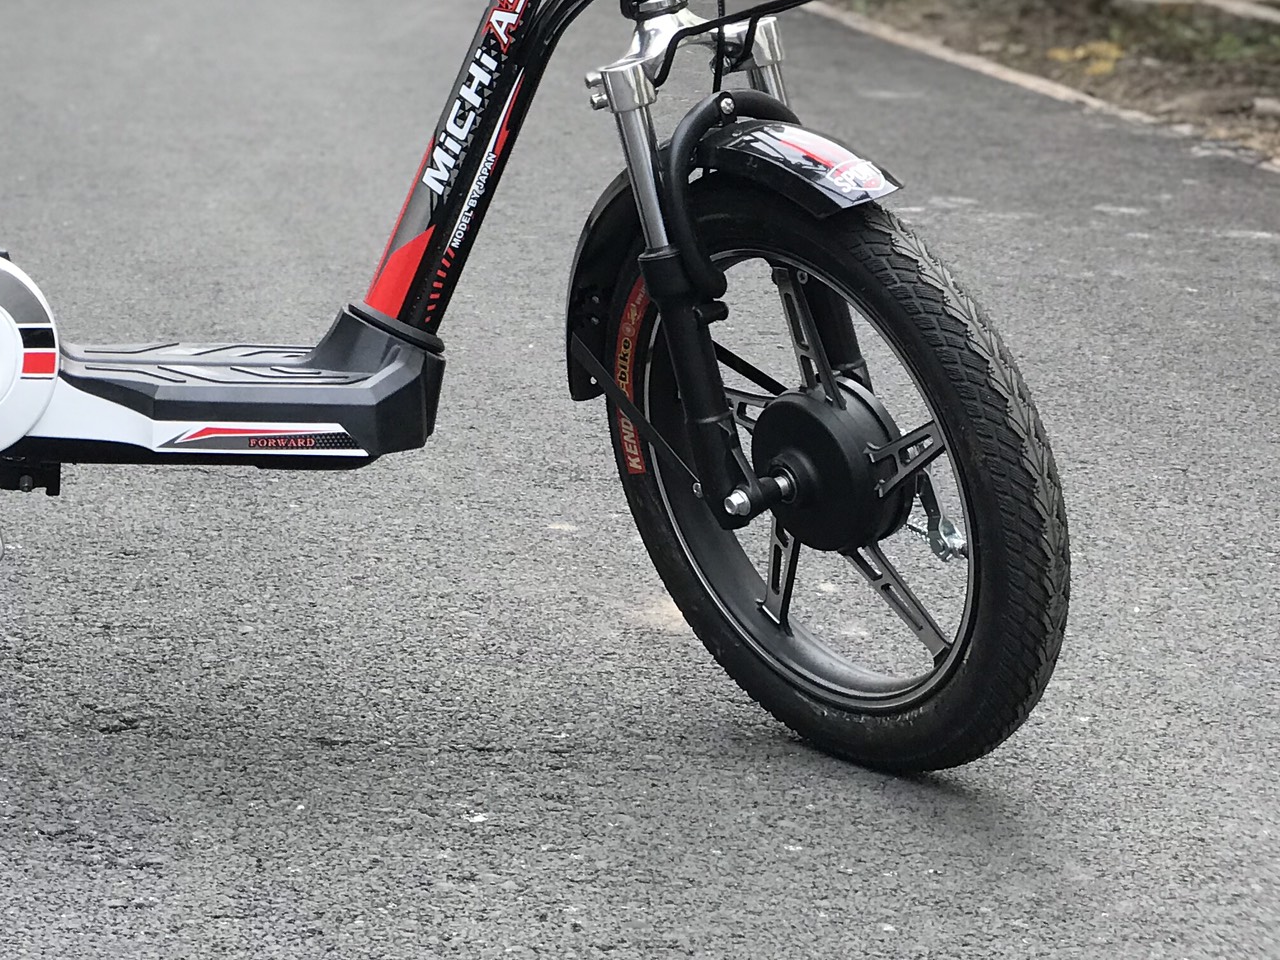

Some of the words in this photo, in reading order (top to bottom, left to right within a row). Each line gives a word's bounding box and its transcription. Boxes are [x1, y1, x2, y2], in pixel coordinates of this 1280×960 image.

[451, 208, 474, 248] MODEL
[467, 192, 480, 209] BY
[477, 152, 497, 191] JAPAN
[249, 438, 315, 447] FORWARD
[620, 406, 643, 470] KEND
